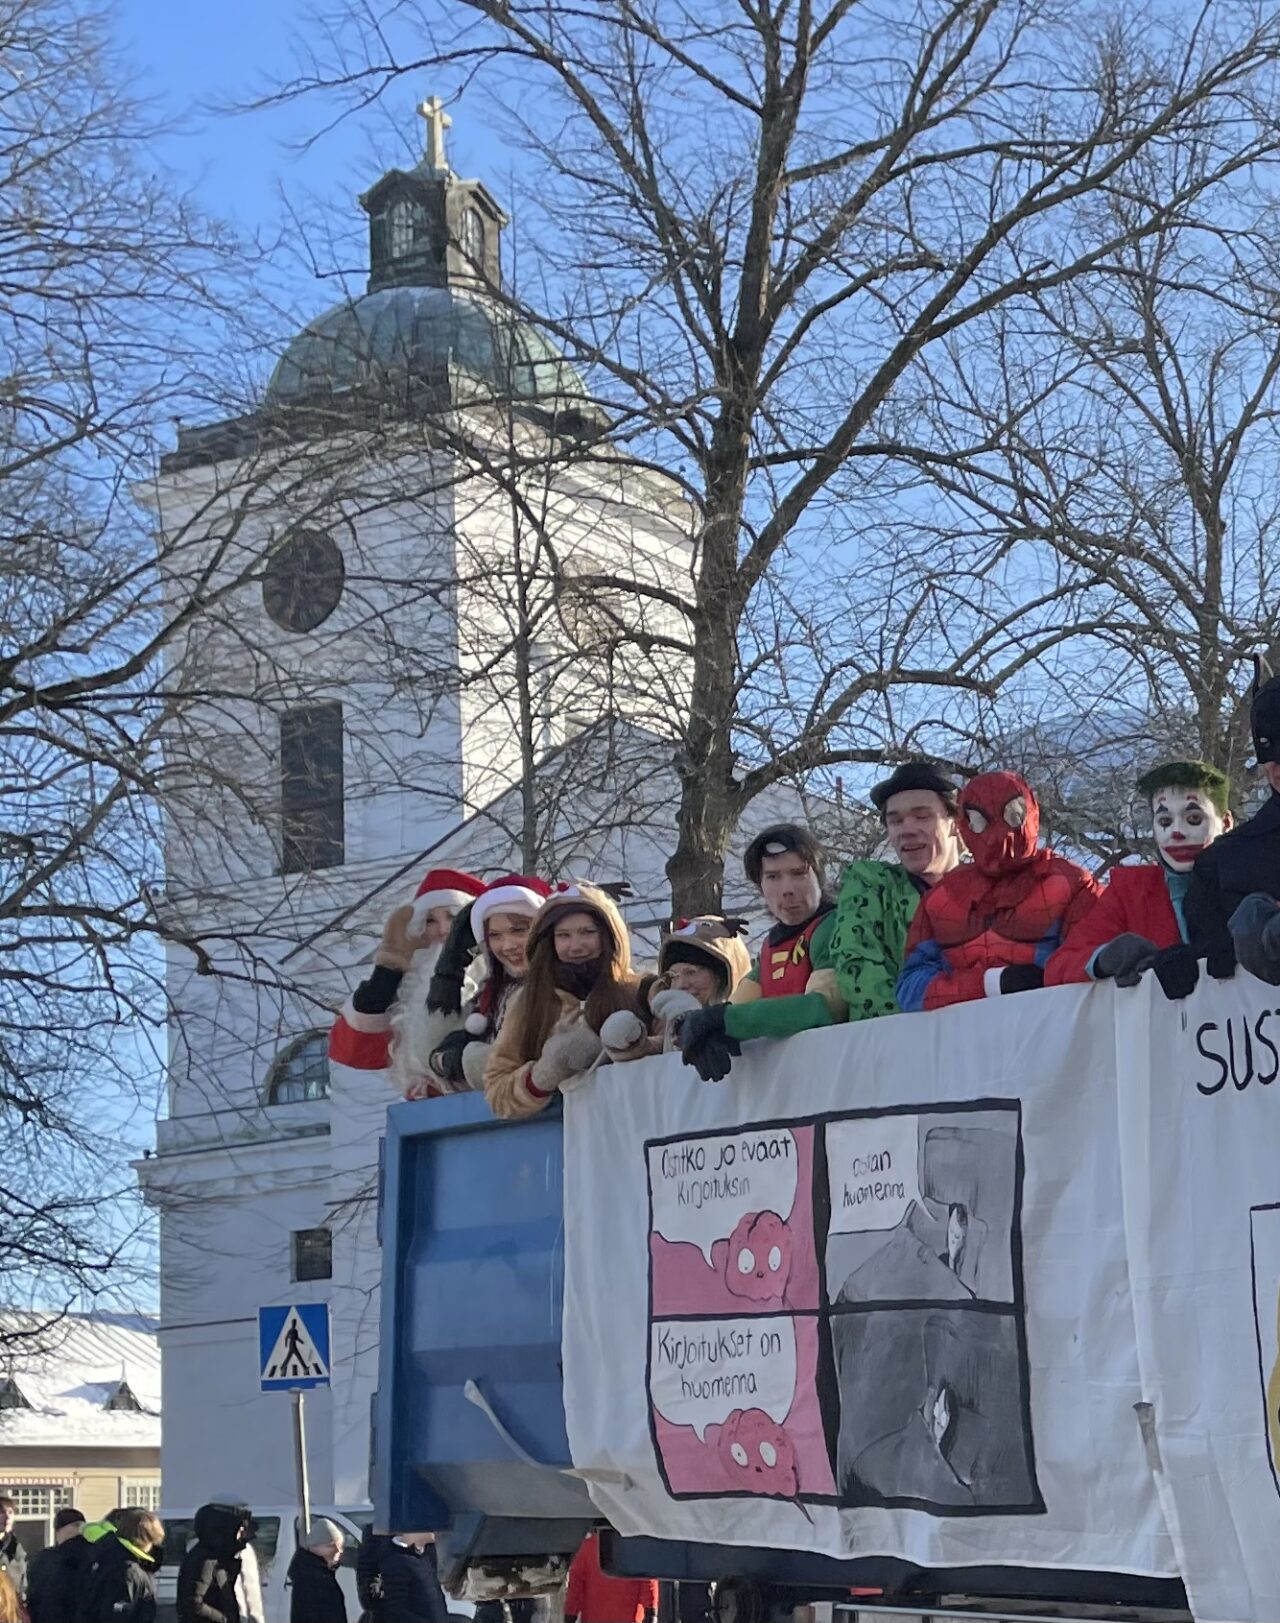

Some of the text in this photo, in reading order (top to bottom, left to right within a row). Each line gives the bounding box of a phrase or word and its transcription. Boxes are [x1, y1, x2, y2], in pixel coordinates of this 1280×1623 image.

[658, 1327, 781, 1369] Kirjoitukset on
[681, 1372, 758, 1399] huomenna
